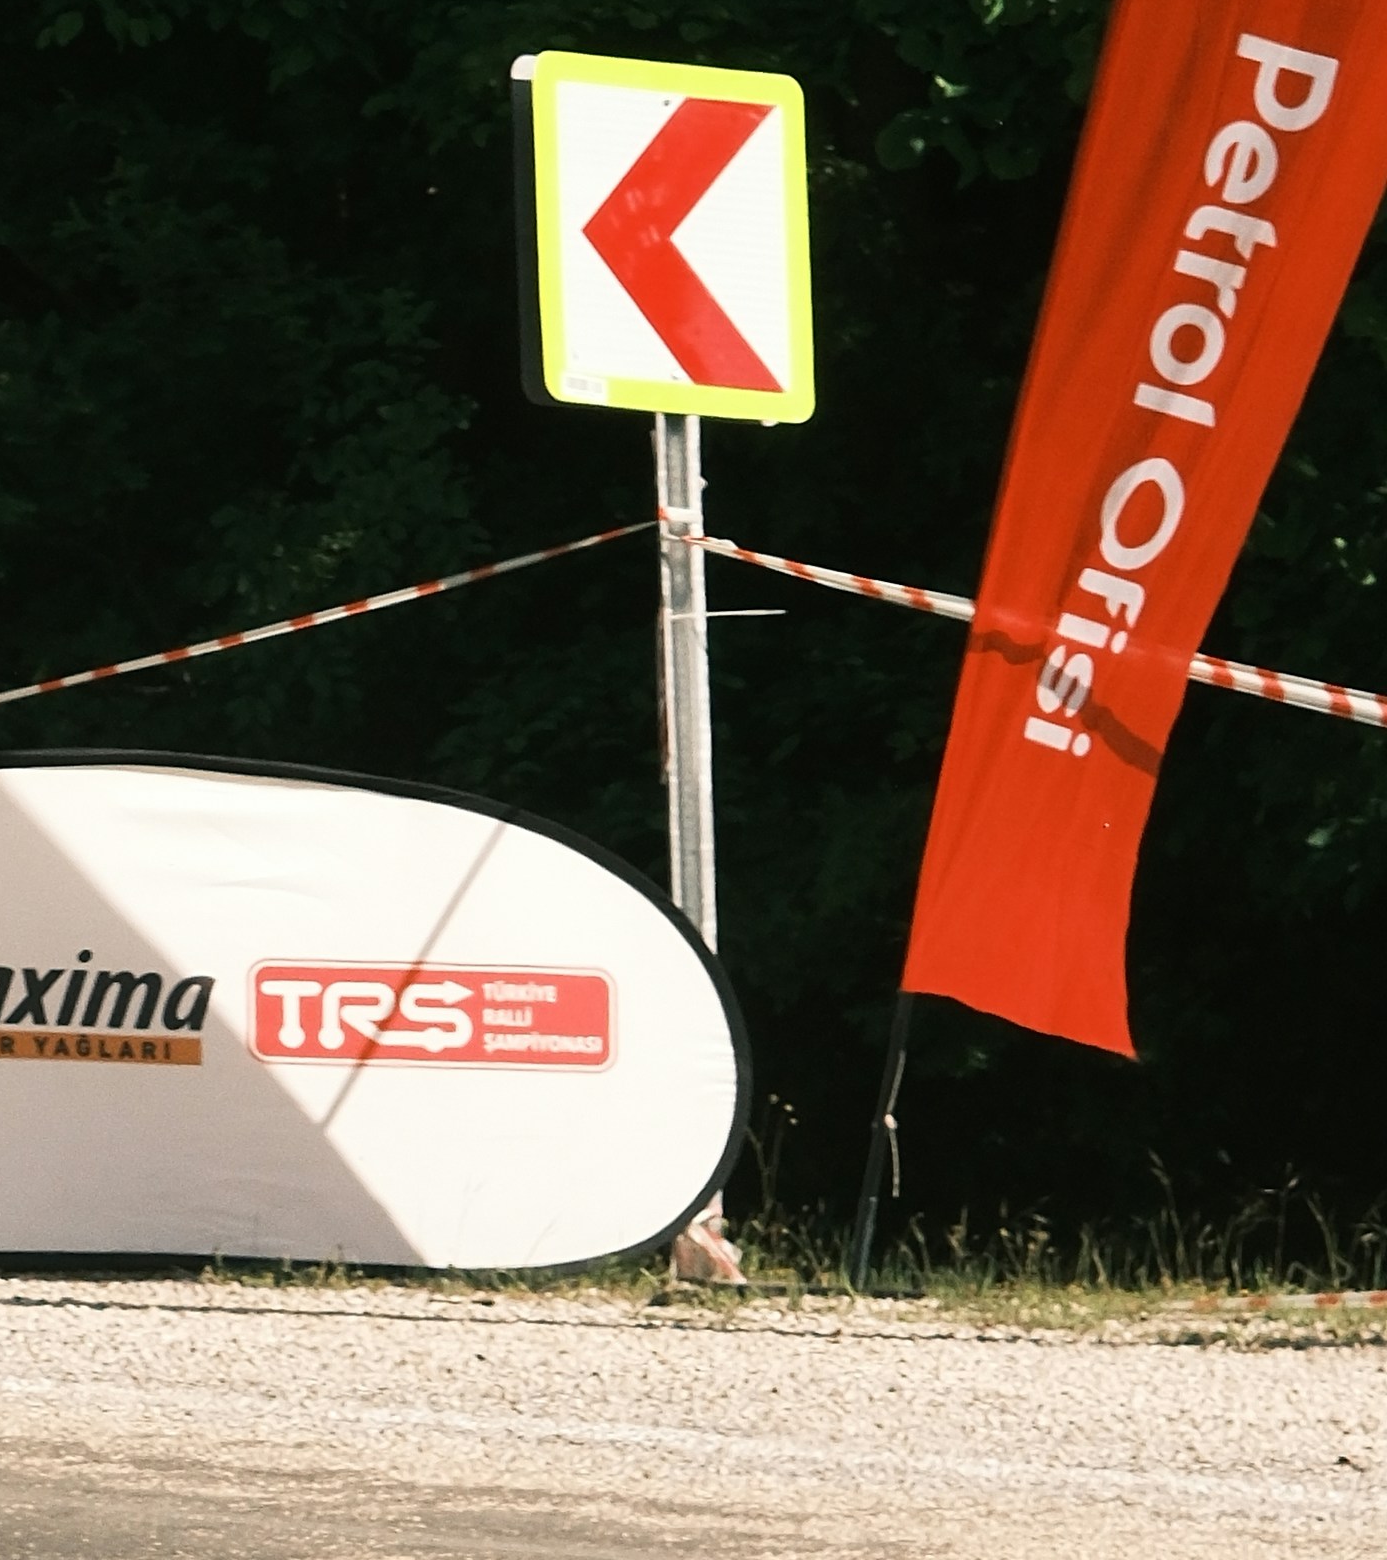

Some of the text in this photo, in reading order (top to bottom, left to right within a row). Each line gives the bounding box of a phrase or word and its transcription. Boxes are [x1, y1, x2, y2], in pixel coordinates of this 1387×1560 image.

[1023, 33, 1339, 758] Petrol Ofisi
[33, 1035, 171, 1060] YAĞLARI
[261, 980, 474, 1052] TRS
